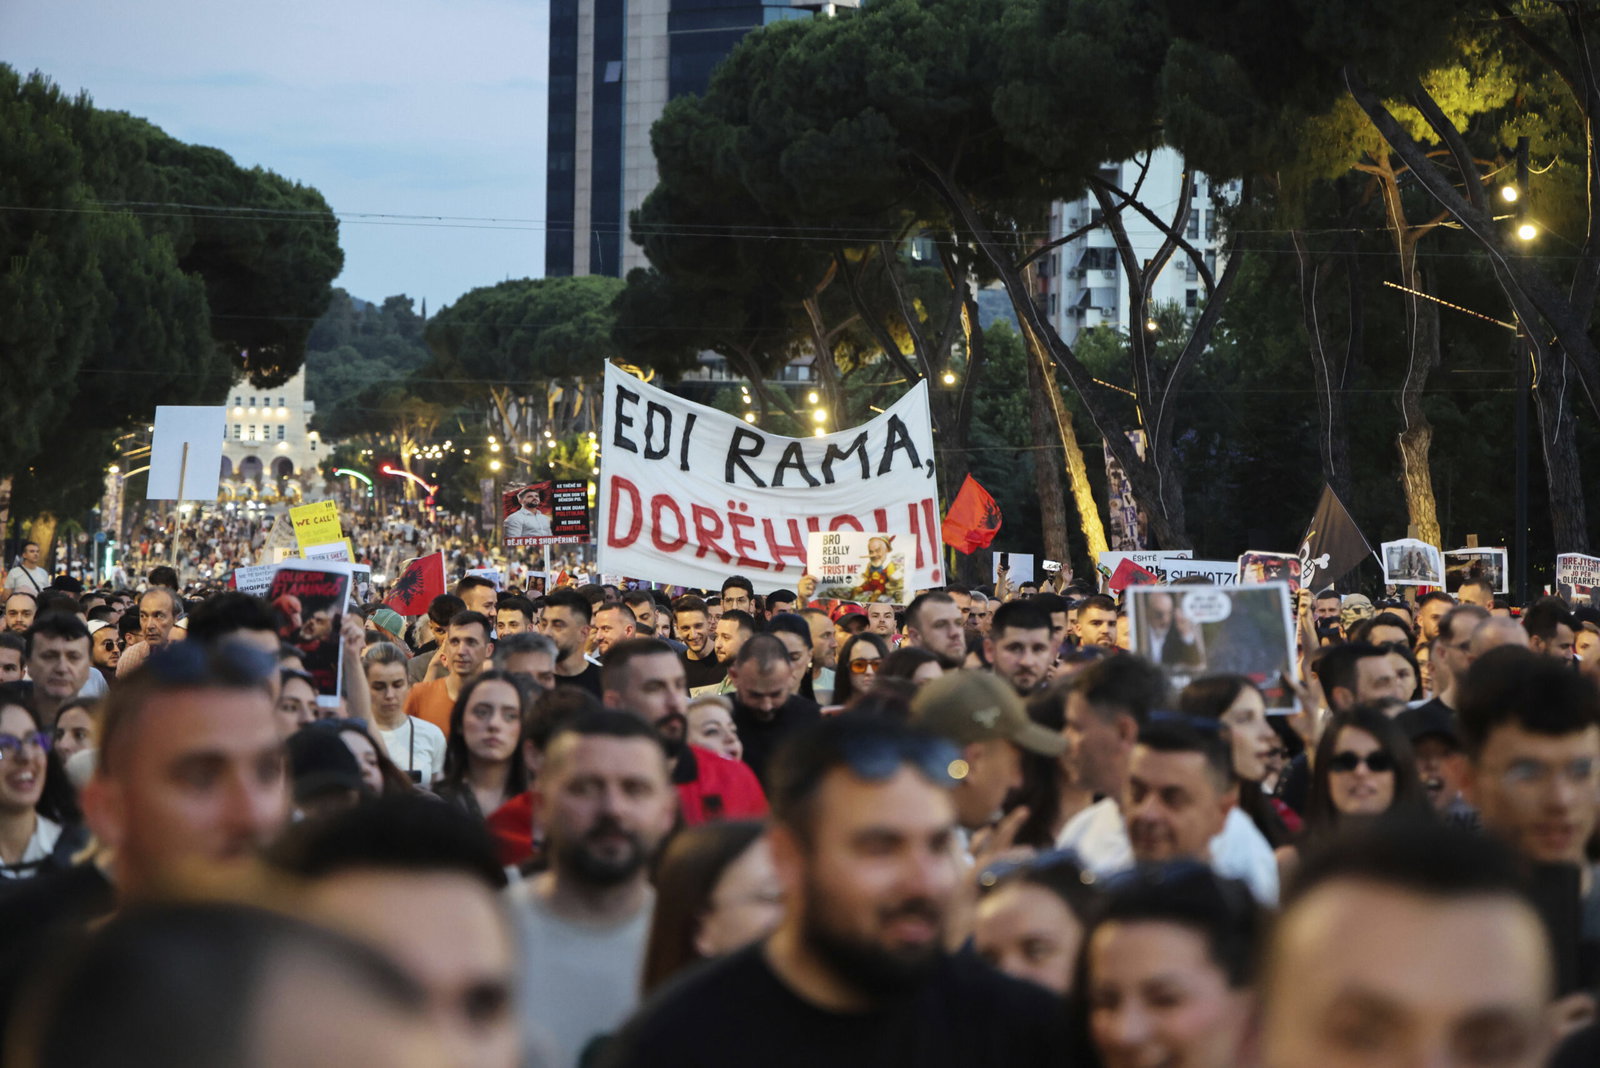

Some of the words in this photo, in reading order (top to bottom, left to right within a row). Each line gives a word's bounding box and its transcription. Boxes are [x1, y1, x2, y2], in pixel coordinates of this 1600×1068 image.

[614, 385, 697, 471] EDI
[725, 413, 934, 488] RAMA,
[296, 518, 310, 527] WE
[525, 537, 537, 545] PËR
[539, 535, 579, 545] SHQIPËRINË!
[822, 533, 841, 546] BRO
[822, 545, 850, 555] REALLY
[822, 556, 840, 565] SAID
[822, 575, 844, 585] AGAIN
